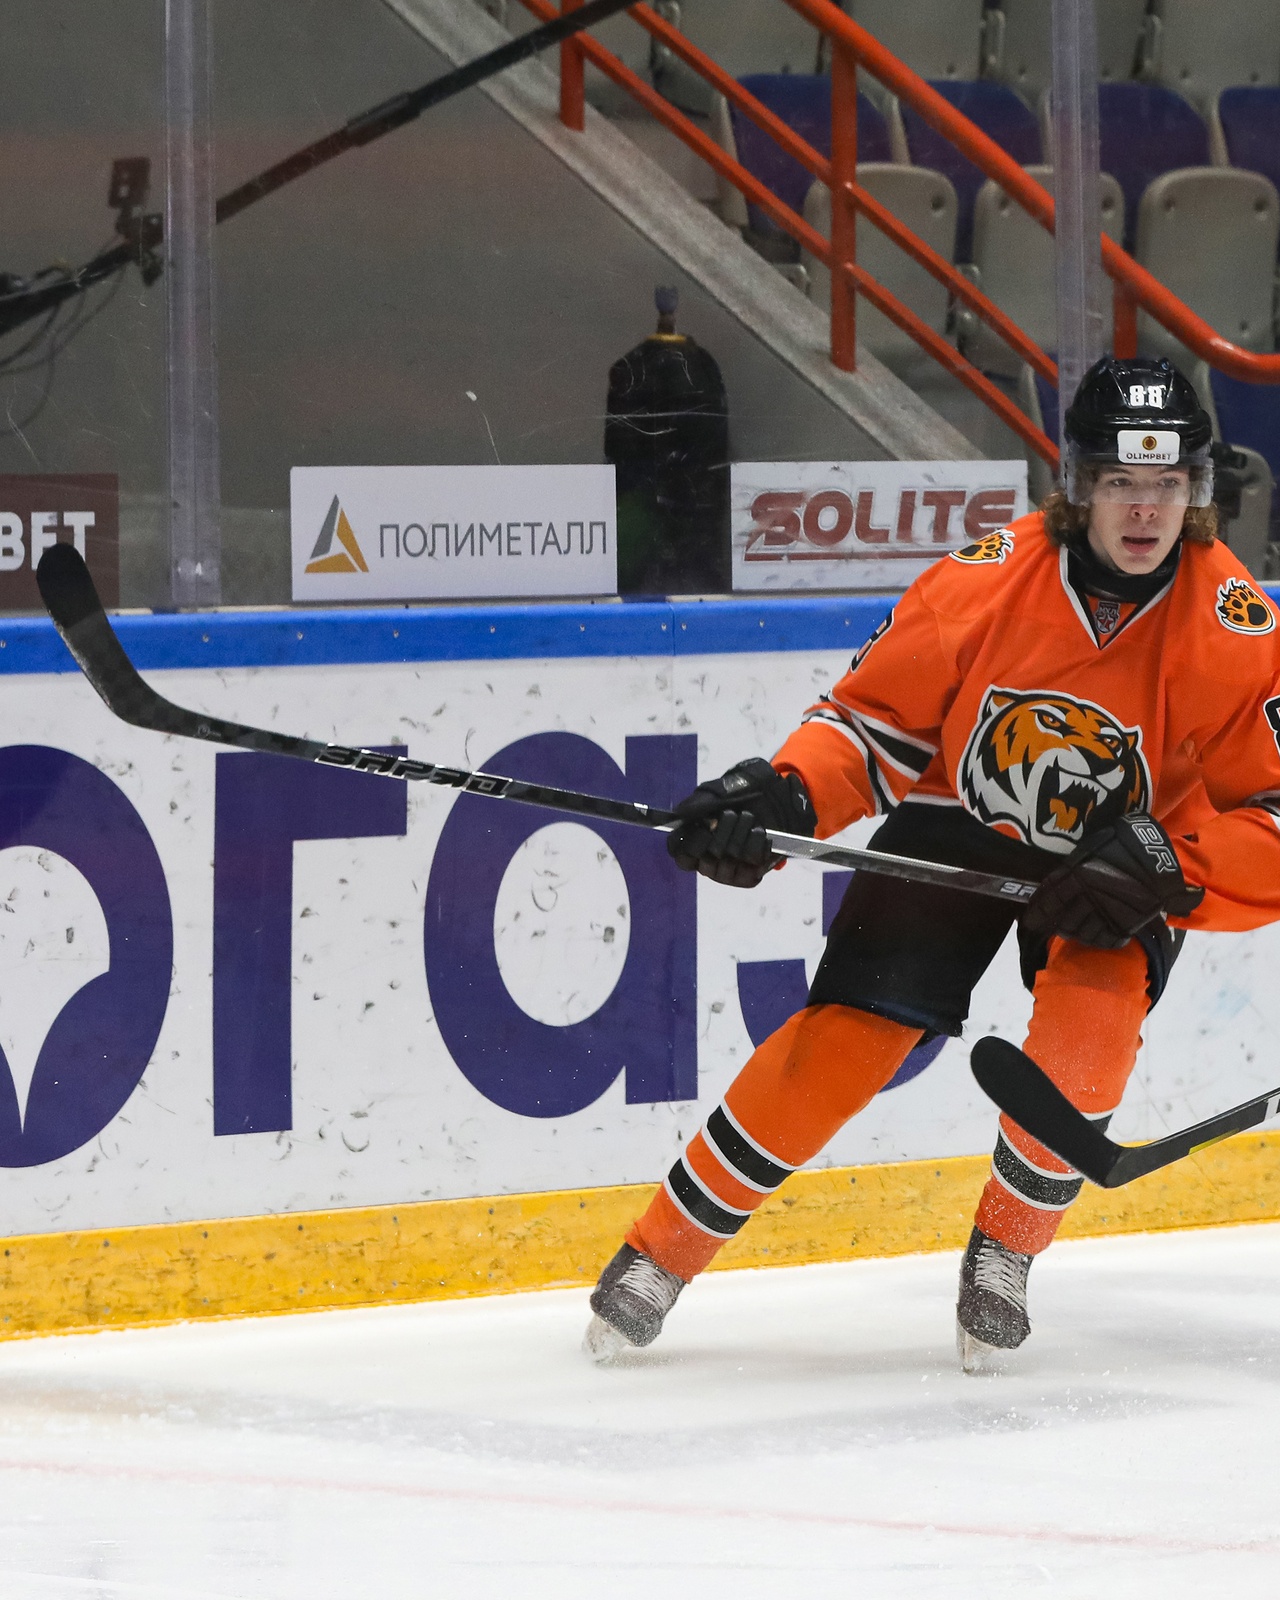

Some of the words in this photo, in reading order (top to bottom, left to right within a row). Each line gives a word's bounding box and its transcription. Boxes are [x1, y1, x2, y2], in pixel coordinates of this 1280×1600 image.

[1129, 385, 1166, 410] 88
[1126, 452, 1172, 461] OLIMPBET
[745, 488, 1017, 549] SOLITE
[379, 520, 607, 558] ПОЛИМЕТАЛЛ
